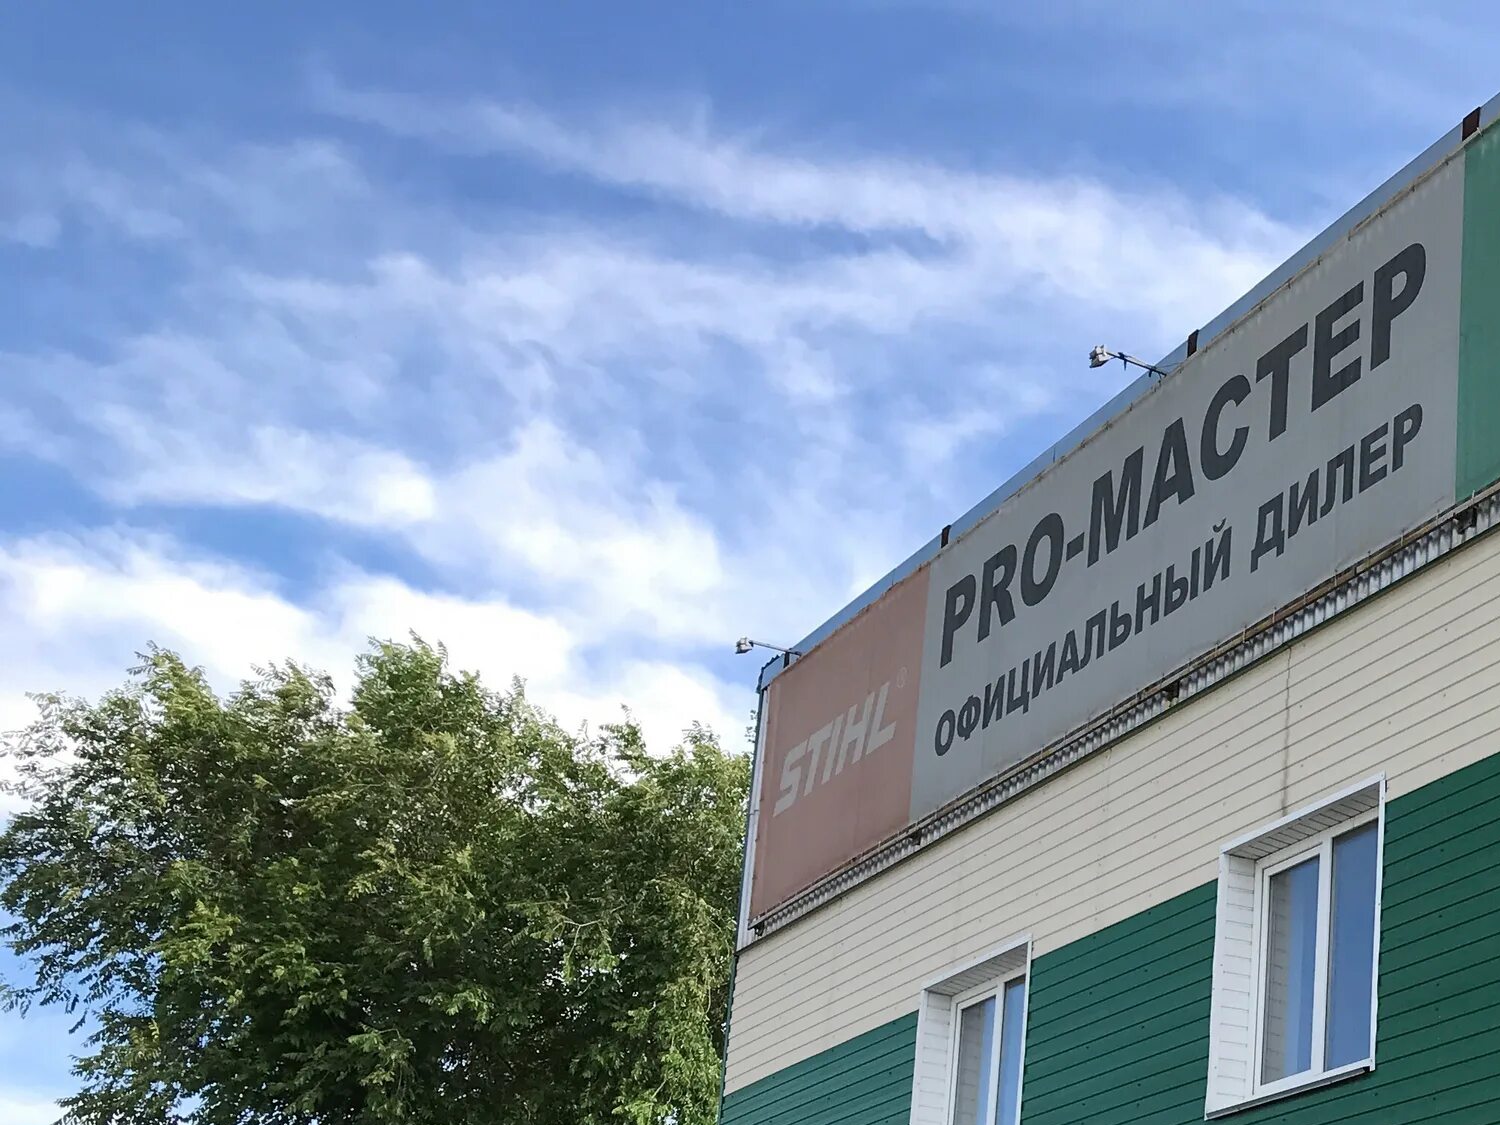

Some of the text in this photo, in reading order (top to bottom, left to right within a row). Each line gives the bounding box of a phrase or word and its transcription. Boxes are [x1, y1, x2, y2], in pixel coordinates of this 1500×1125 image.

[934, 403, 1423, 757] ОФИЦИАЛЬНЫЙ ДИЛЕР
[938, 242, 1427, 669] PRO-МАСТЕР
[772, 681, 897, 819] STIHL
